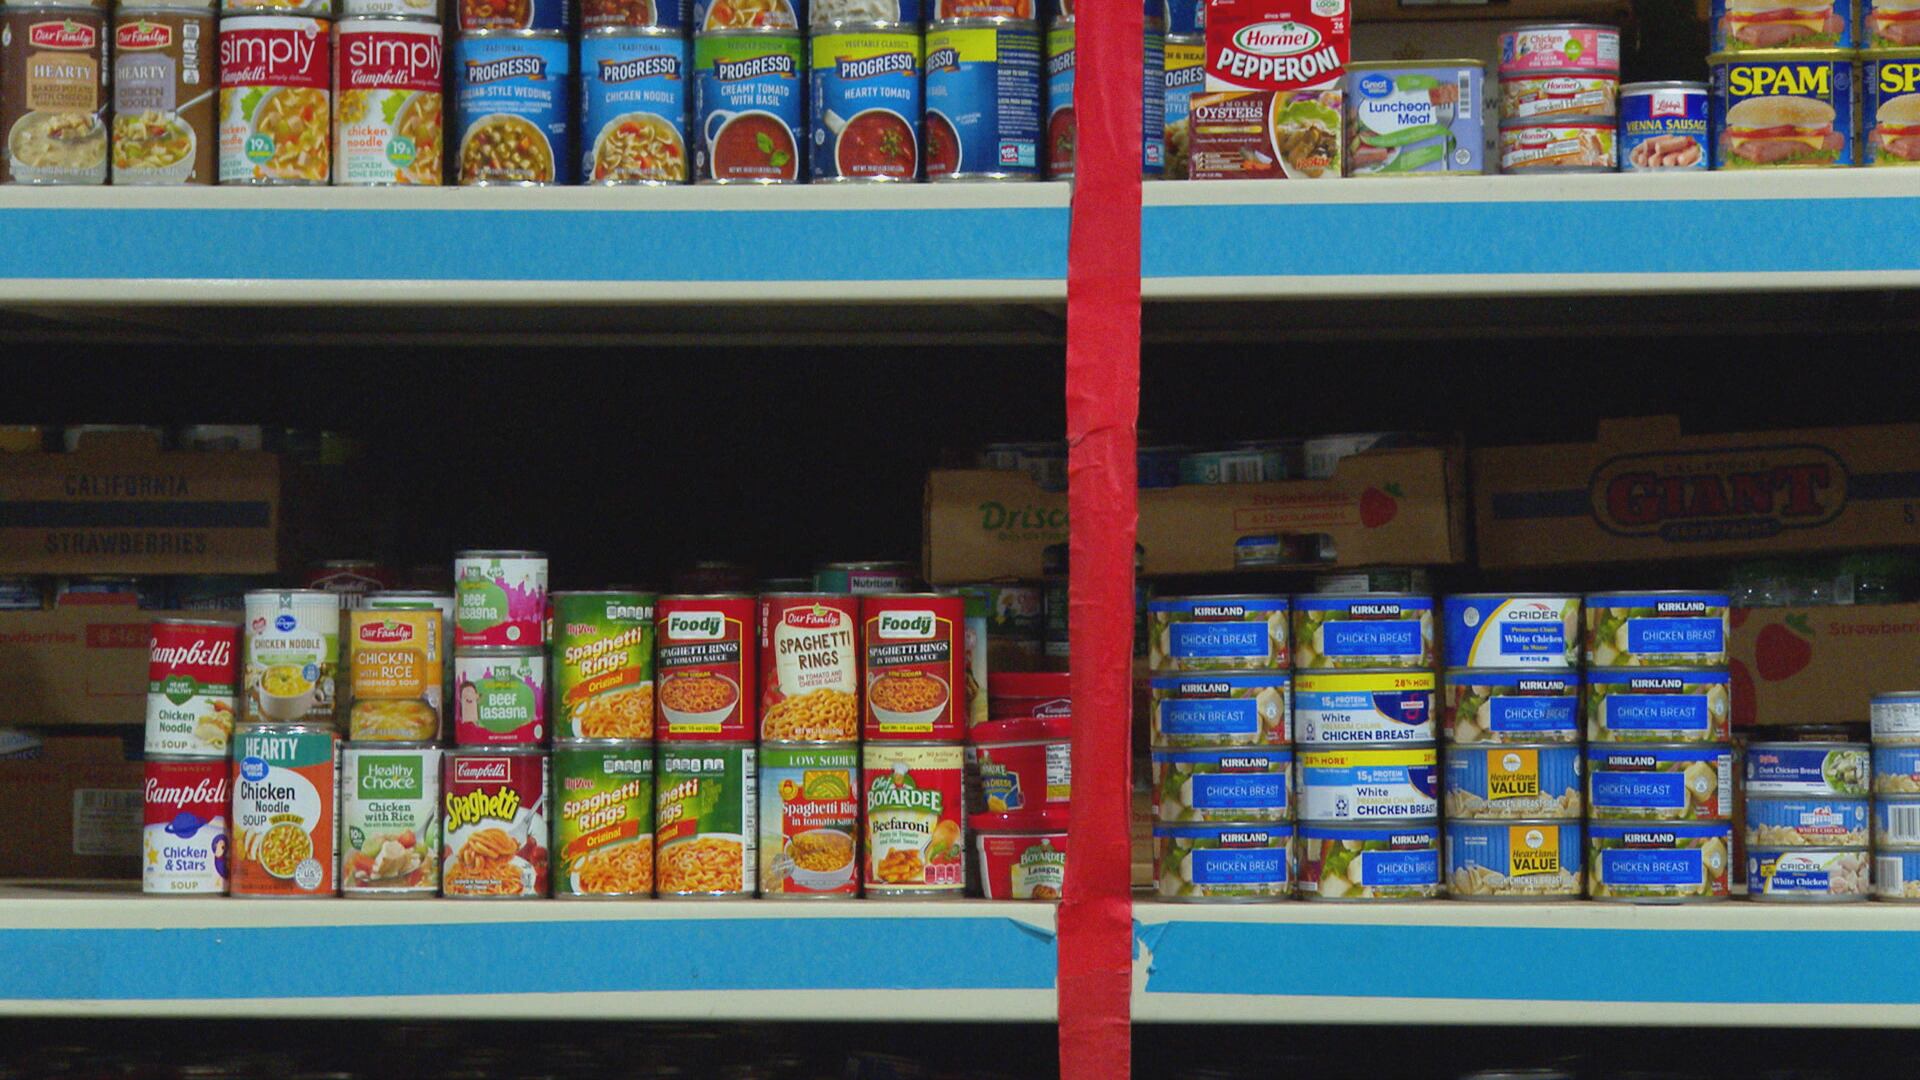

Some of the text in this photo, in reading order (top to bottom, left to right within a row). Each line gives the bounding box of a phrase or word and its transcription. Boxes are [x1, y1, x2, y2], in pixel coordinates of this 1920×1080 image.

[56, 30, 91, 43] Family
[132, 29, 167, 43] Family
[1246, 30, 1309, 46] Hormel
[1530, 34, 1563, 45] Chicken
[220, 31, 315, 74] simply
[349, 34, 442, 79] simply
[469, 58, 540, 82] PROGRESSO
[604, 58, 675, 82] PROGRESSO
[719, 56, 791, 80] PROGRESSO
[841, 54, 912, 78] PROGRESSO
[1216, 46, 1341, 82] PEPPERONI
[34, 65, 90, 78] HEARTY
[118, 65, 167, 79] HEARTY
[351, 69, 408, 86] Campbell's
[1362, 80, 1387, 89] Great
[1546, 82, 1577, 90] Hormel
[1729, 66, 1830, 96] SPAM
[721, 83, 790, 96] CREAMY TOMATO
[844, 87, 911, 100] HEARTY TOMATO
[606, 90, 675, 104] CHICKEN NOODLE
[731, 94, 780, 106] WITH BASIL
[1368, 101, 1432, 112] Luncheon
[1656, 100, 1682, 111] Libby's
[1195, 106, 1264, 118] OYSTERS
[1398, 114, 1431, 124] Meat
[347, 126, 388, 136] chicken
[1626, 120, 1663, 132] VIENNA
[347, 137, 383, 147] noodle
[1520, 132, 1550, 140] Hormel
[64, 475, 190, 496] CALIFORNIA
[1606, 463, 1830, 526] GIANT
[45, 533, 207, 554] STRAWBERRIES
[852, 578, 894, 588] Nutrition
[1194, 607, 1244, 616] KIRKLAND
[1351, 606, 1400, 614] KIRKLAND
[1658, 602, 1706, 612] KIRKLAND
[788, 612, 838, 626] Our Family
[1508, 610, 1558, 620] CRIDER
[377, 627, 412, 641] Family
[1181, 634, 1257, 645] CHICKEN BREAST
[1336, 632, 1412, 644] CHICKEN BREAST
[1504, 634, 1563, 643] White Chicken
[1642, 630, 1717, 641] CHICKEN BREAST
[254, 639, 320, 649] CHICKEN NOODLE
[565, 626, 642, 665] Spaghetti
[780, 631, 850, 655] SPAGHETTI
[869, 642, 948, 656] SPAGHETTI RINGS
[660, 642, 738, 658] SPAGHETTI RINGS
[358, 653, 414, 666] CHICKEN
[580, 650, 628, 676] Rings
[673, 656, 702, 665] TOMATO
[703, 654, 727, 662] SAUCE
[798, 651, 839, 670] RINGS
[884, 656, 912, 664] TOMATO
[360, 666, 412, 678] WITH RICE
[806, 672, 830, 682] TOMATO
[831, 670, 842, 678] AND
[588, 672, 624, 693] Original
[800, 676, 842, 688] CHEESE SAUCE
[1181, 684, 1229, 692] KIRKLAND
[1520, 680, 1564, 690] KIRKLAND
[1632, 679, 1682, 688] KIRKLAND
[1336, 696, 1366, 704] PROTEIN
[158, 710, 195, 721] Chicken
[480, 706, 527, 720] lasagna
[1170, 711, 1244, 722] CHICKEN BREAST
[1322, 713, 1351, 722] White
[1504, 708, 1571, 720] CHICKEN BREAST
[1617, 707, 1696, 718] CHICKEN BREAST
[159, 722, 192, 734] Noodle
[1322, 730, 1414, 741] CHICKEN BREAST
[245, 738, 298, 760] HEARTY
[789, 756, 815, 766] LOW
[1222, 758, 1268, 768] KIRKLAND
[1320, 757, 1345, 765] MORE
[1608, 756, 1656, 766] KIRKLAND
[368, 764, 414, 777] Healthy
[458, 762, 506, 778] Campbell's
[1357, 771, 1372, 782] 15g
[1373, 770, 1403, 778] PROTEIN
[362, 776, 416, 790] Choice
[871, 776, 892, 791] Chef
[1490, 773, 1536, 782] Heartland
[240, 781, 296, 801] Chicken
[1206, 786, 1280, 797] CHICKEN BREAST
[1357, 788, 1389, 797] White
[1490, 782, 1536, 794] VALUE
[1598, 784, 1670, 795] CHICKEN BREAST
[563, 779, 640, 819] Spaghetti
[867, 790, 942, 812] BOYARDEE
[1487, 800, 1518, 809] CHICKEN
[256, 801, 290, 813] Noodle
[368, 802, 411, 812] Chicken
[446, 786, 520, 832] Spaghetti
[782, 802, 838, 816] Spaghetti
[1357, 805, 1408, 816] CHICKEN
[242, 815, 267, 826] SOUP
[365, 812, 414, 822] with Rice
[579, 803, 626, 832] Rings
[872, 816, 929, 834] Beefaroni
[586, 826, 622, 847] Original
[1220, 833, 1268, 843] KIRKLAND
[1392, 835, 1430, 845] KIRKLAND
[1624, 834, 1674, 843] KIRKLAND
[163, 846, 208, 858] Chicken
[1513, 850, 1557, 858] Heartland
[1020, 852, 1066, 865] BOYARDEE
[1513, 859, 1557, 870] VALUE
[164, 859, 206, 871] & Stars
[1028, 866, 1060, 876] Lasagna
[1206, 860, 1279, 872] CHICKEN BREAST
[1612, 862, 1690, 873] CHICKEN BREAST
[170, 882, 199, 890] SOUP
[1772, 878, 1828, 886] White Chicken
